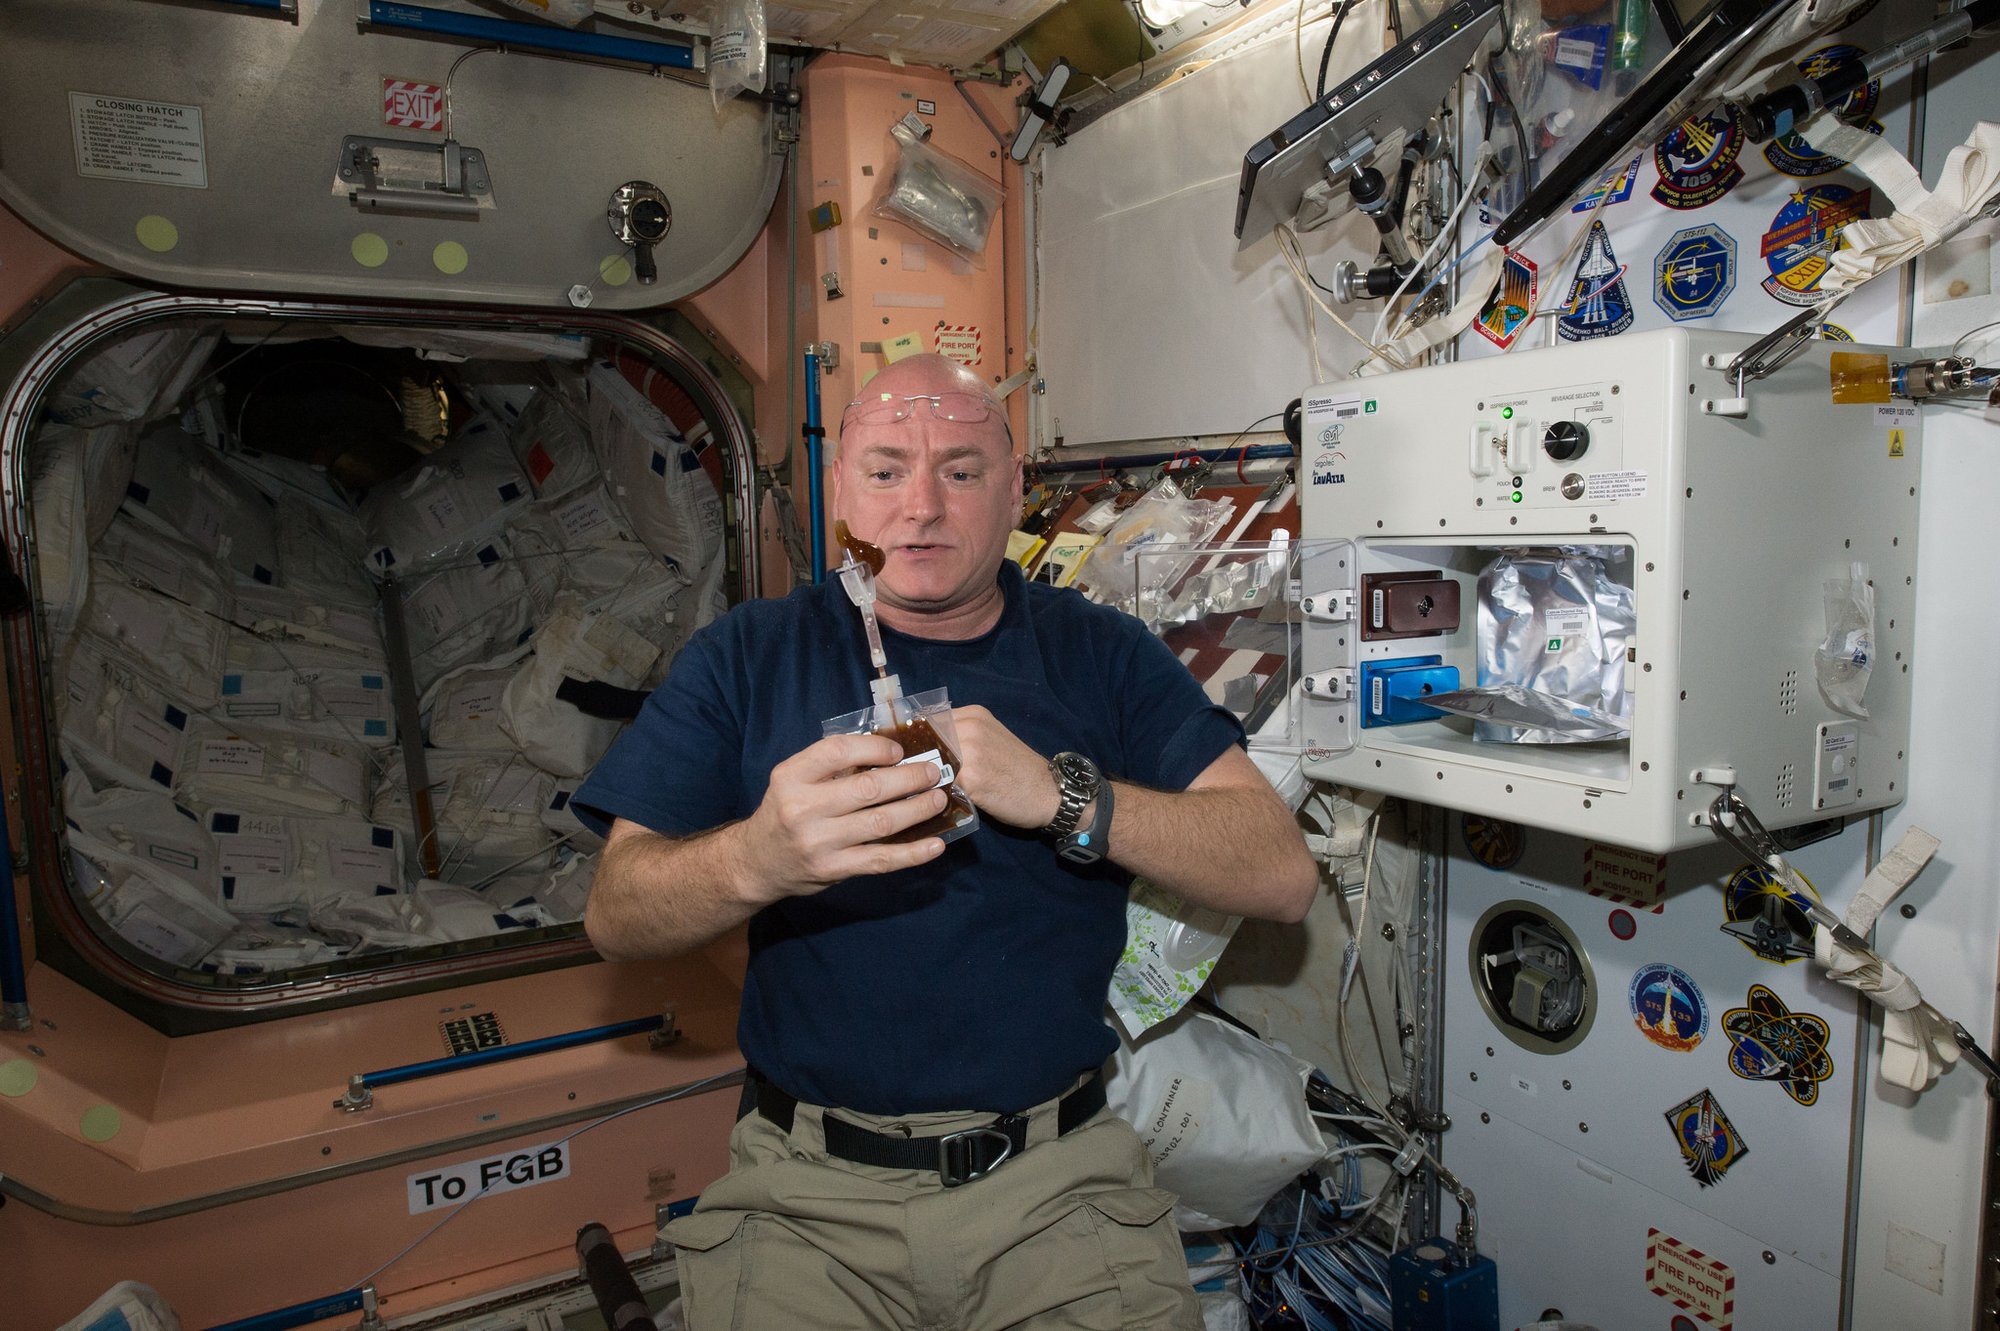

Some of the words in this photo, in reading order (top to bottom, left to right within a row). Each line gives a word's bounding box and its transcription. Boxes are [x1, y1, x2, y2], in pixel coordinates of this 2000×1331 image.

[96, 100, 143, 112] CLOSING
[147, 106, 183, 116] HATCH
[394, 91, 433, 120] EXIT
[1658, 155, 1670, 178] BARRY
[1768, 153, 1807, 175] CULBERTSON
[1681, 172, 1712, 187] 105
[1682, 186, 1716, 199] CULBERTSON
[1683, 228, 1707, 239] STS-112
[1768, 220, 1804, 240] WETHERBEE
[1512, 254, 1530, 267] FRICK
[1785, 260, 1824, 286] CXIII
[1582, 310, 1609, 325] 111
[1480, 327, 1497, 341] OCHOA
[1551, 394, 1575, 402] BEVERAGE
[1313, 472, 1345, 485] LAVAZZA
[1594, 844, 1639, 859] EMERGENCY
[1641, 856, 1656, 865] USE
[1594, 861, 1619, 876] FIRE
[1623, 867, 1654, 884] PORT
[1645, 1000, 1662, 1012] STS
[1673, 1010, 1691, 1022] 133
[1801, 1017, 1824, 1035] JOHNSON
[1153, 1078, 1182, 1133] CONTAINER
[416, 1175, 466, 1206] To
[480, 1147, 563, 1192] FGB
[1657, 1243, 1706, 1272] EMERGENCY
[1708, 1269, 1723, 1282] USE
[1658, 1260, 1685, 1281] FIRE
[1688, 1275, 1722, 1300] PORT
